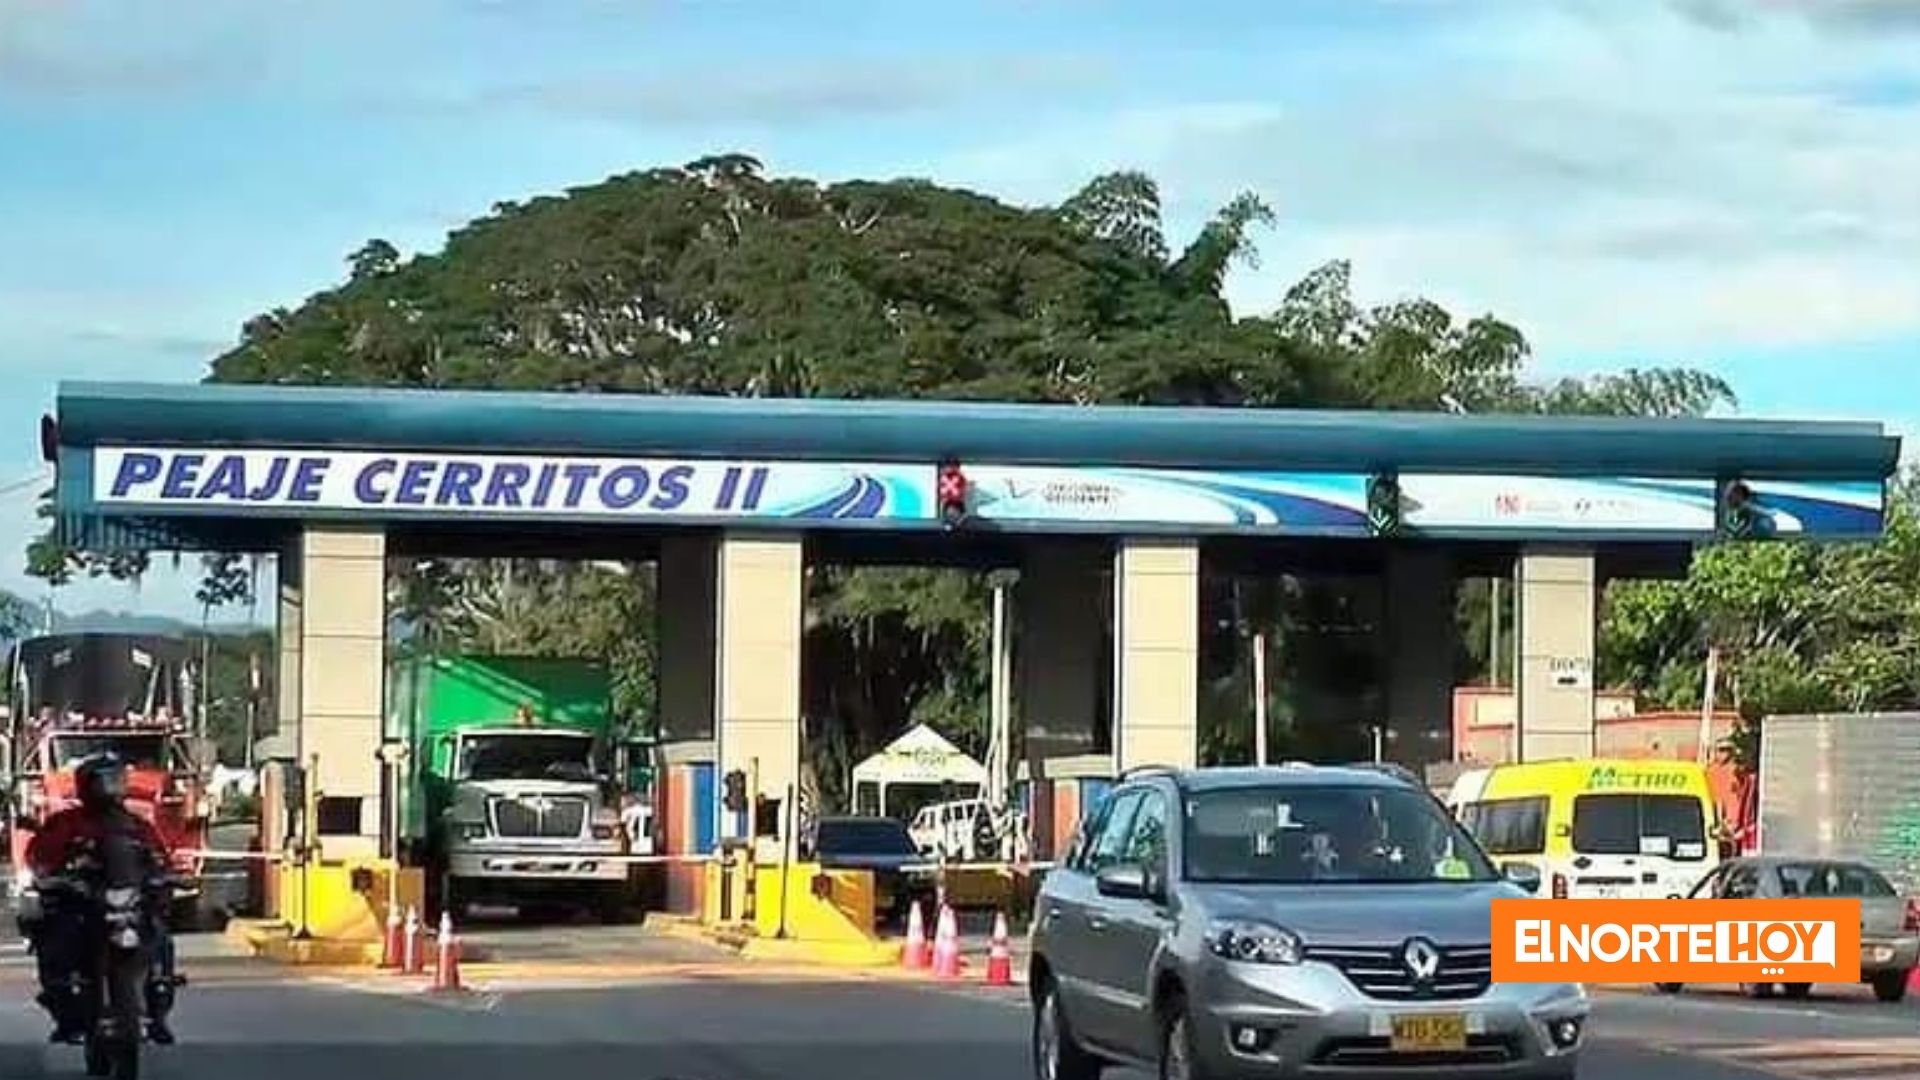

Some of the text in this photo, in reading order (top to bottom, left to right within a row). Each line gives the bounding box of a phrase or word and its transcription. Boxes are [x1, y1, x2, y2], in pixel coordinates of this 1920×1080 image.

[110, 453, 769, 511] PEAJE CERRITOS II
